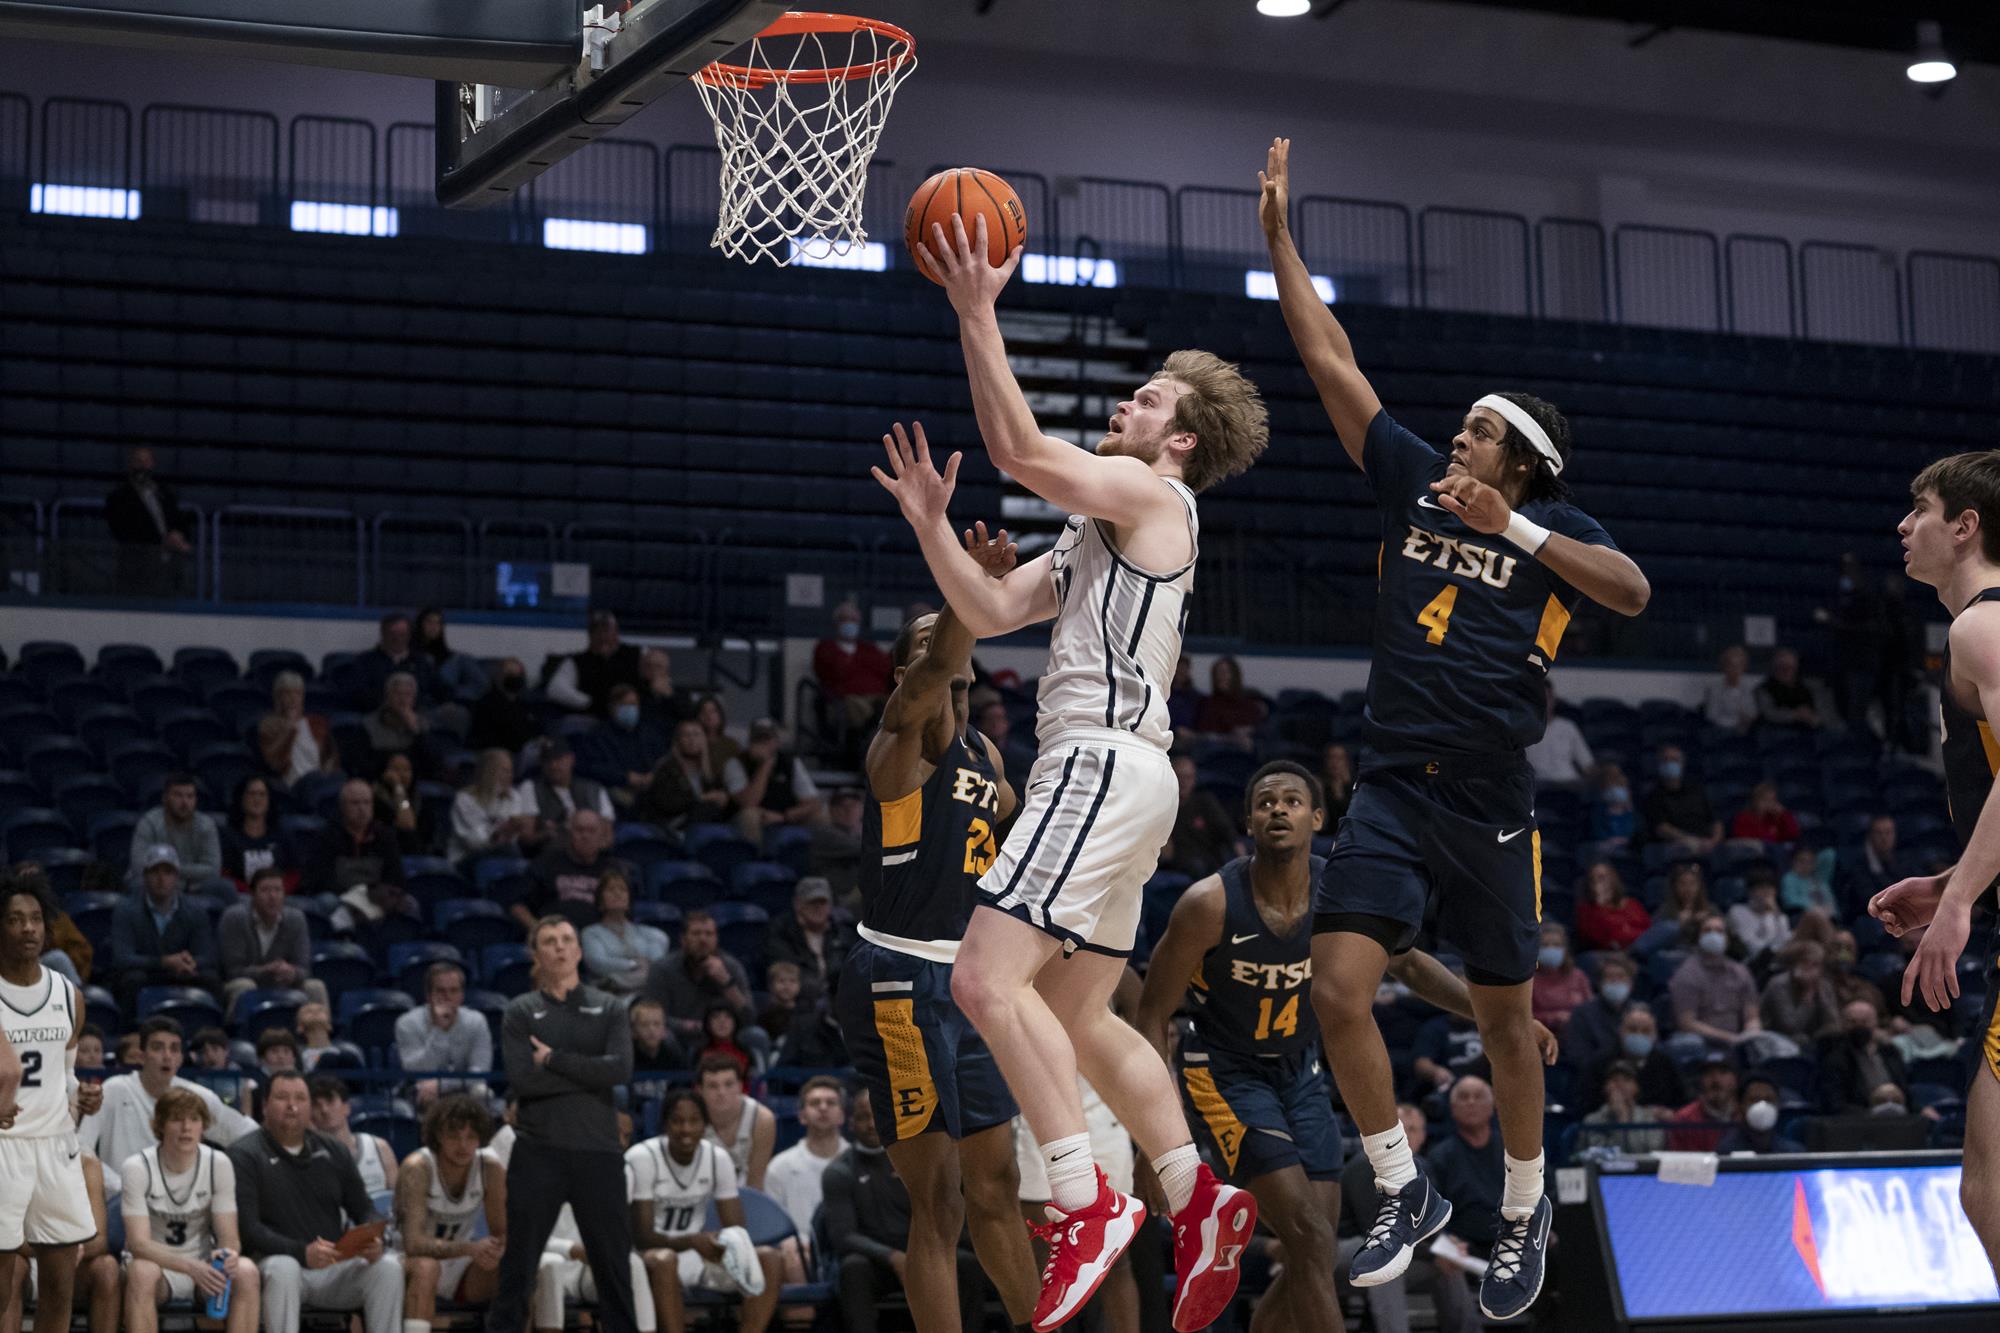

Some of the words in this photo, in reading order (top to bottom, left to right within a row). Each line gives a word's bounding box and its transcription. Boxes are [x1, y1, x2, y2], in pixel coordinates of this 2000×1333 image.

[1402, 525, 1516, 589] ETSU
[1417, 584, 1458, 645] 4
[1255, 993, 1299, 1040] 14
[20, 1051, 42, 1087] 2
[898, 1087, 925, 1117] E
[165, 1221, 187, 1247] 3
[662, 1205, 695, 1231] 10
